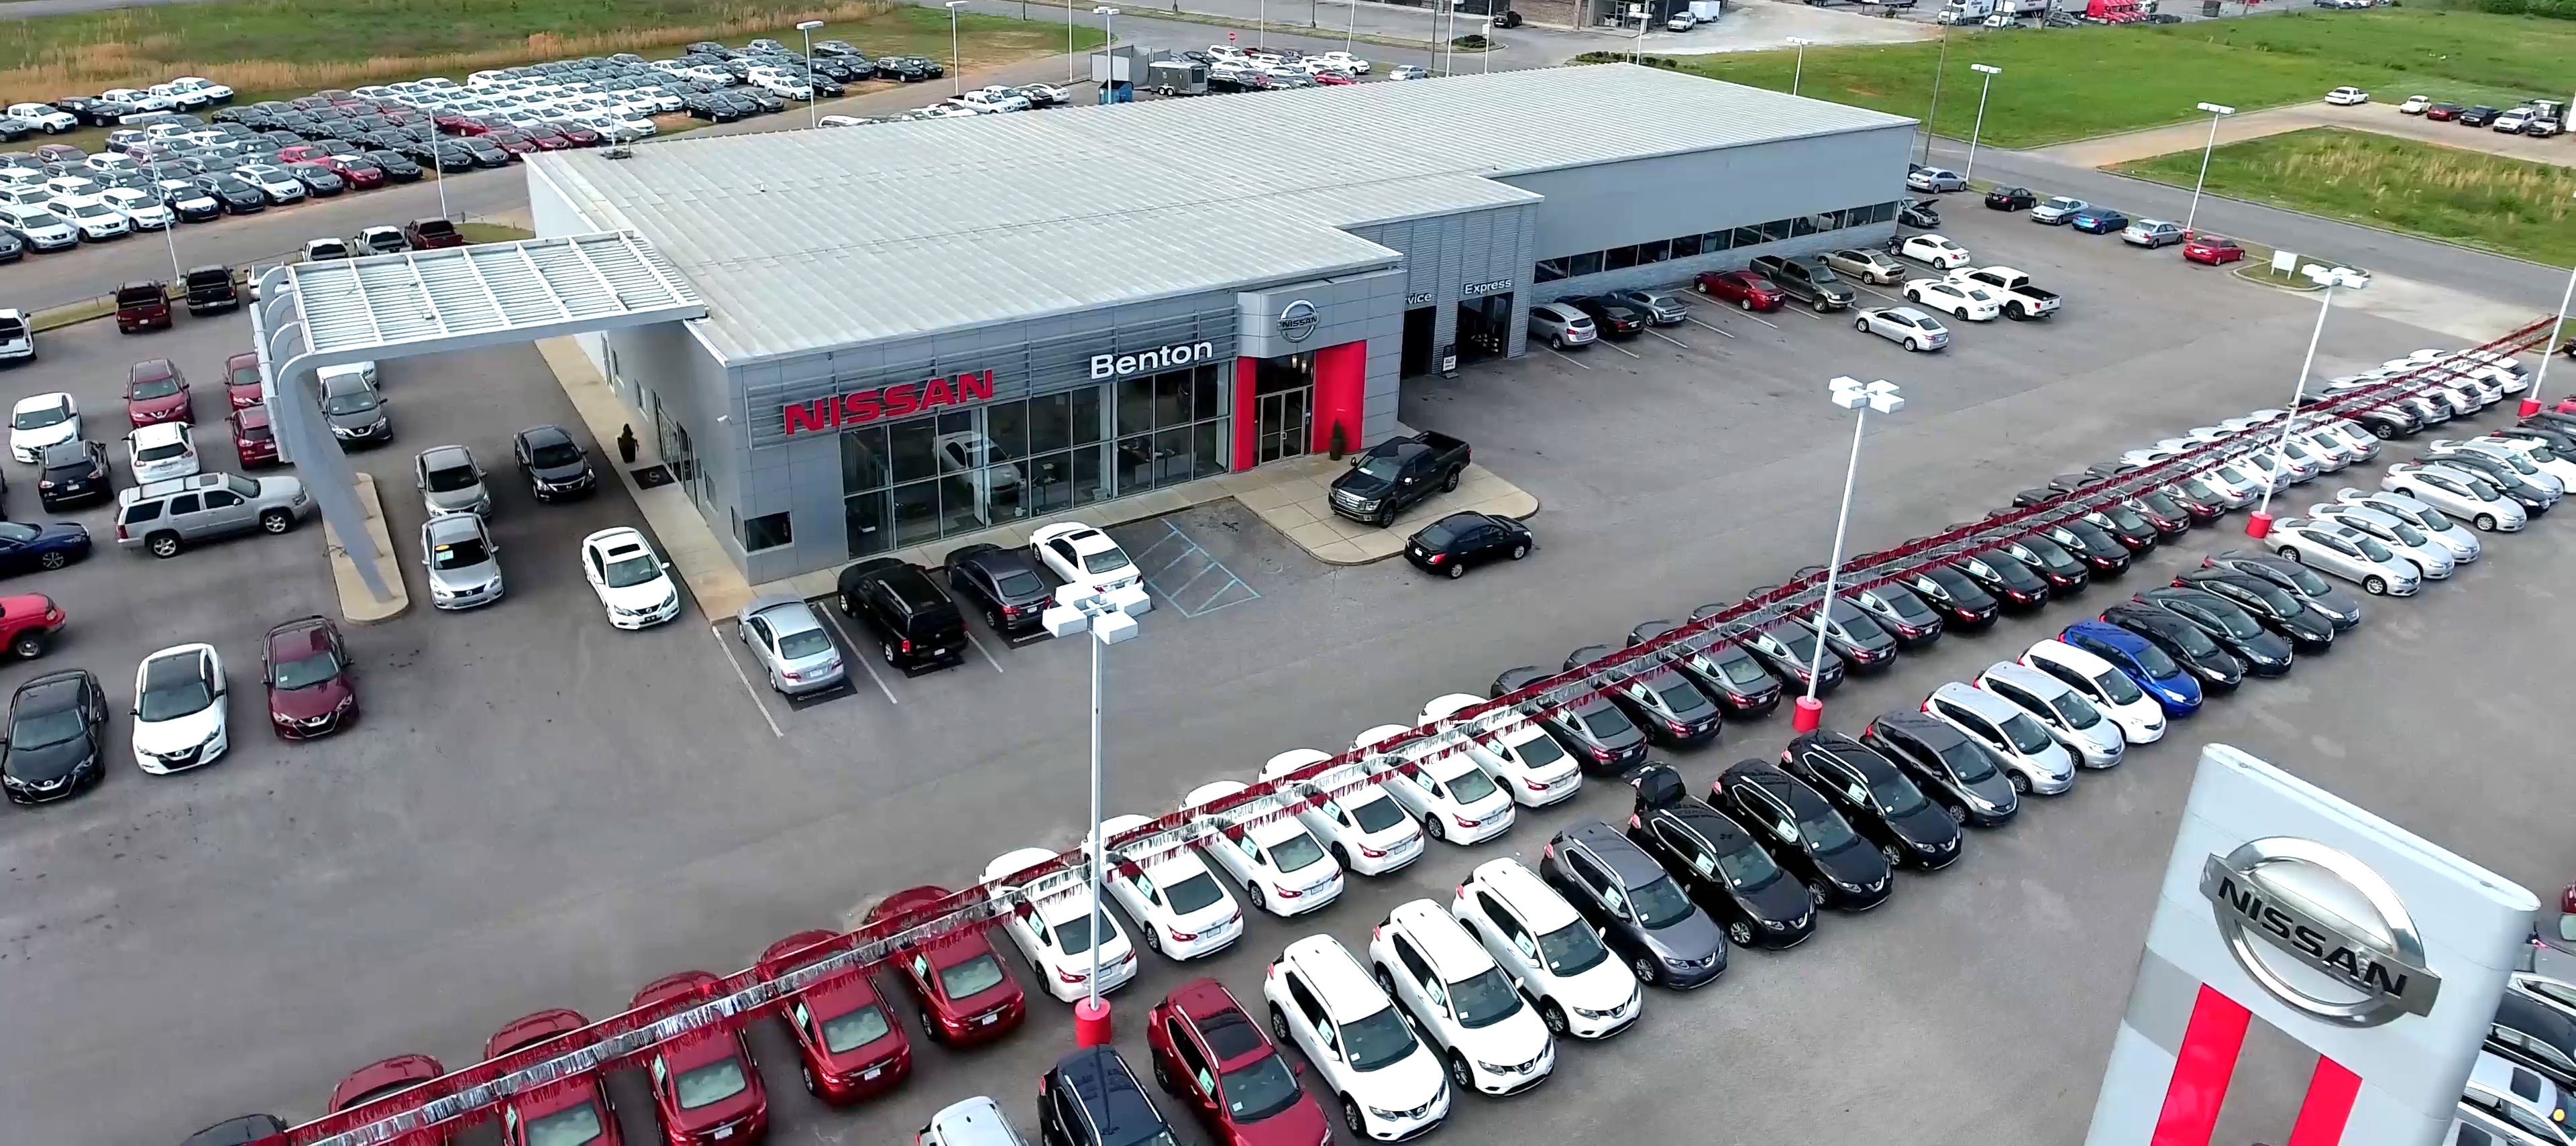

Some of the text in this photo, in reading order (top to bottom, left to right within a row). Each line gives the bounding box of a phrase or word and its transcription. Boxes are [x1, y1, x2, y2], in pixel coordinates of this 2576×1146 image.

[1405, 293, 1432, 304] vice
[1464, 279, 1511, 294] Express
[1282, 317, 1318, 328] NISSAN
[1091, 341, 1213, 380] Benton
[784, 369, 994, 436] NISSAN
[2218, 876, 2408, 999] NISSAN
